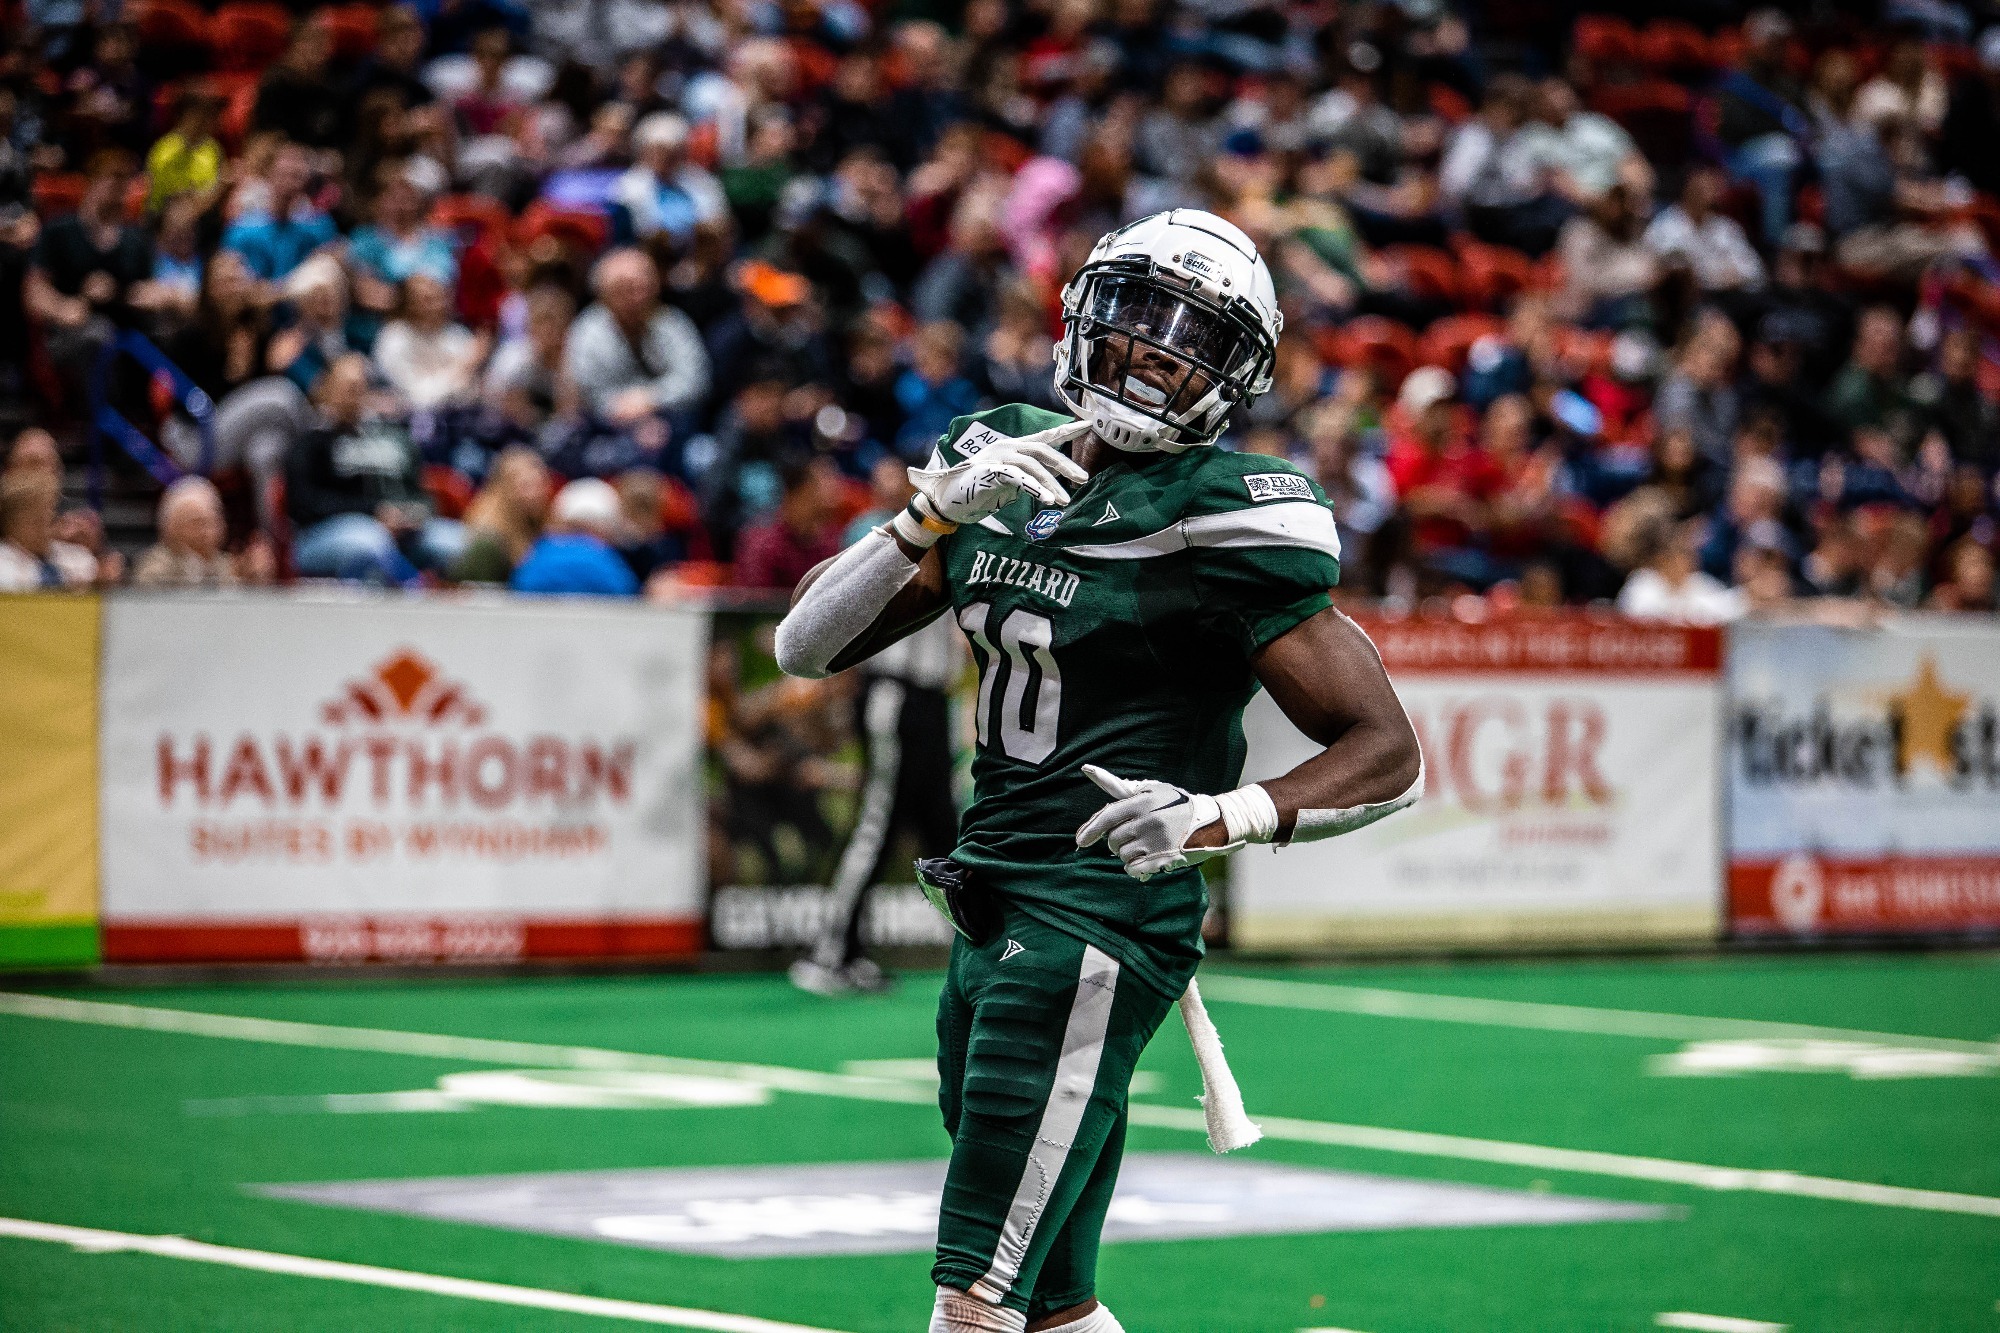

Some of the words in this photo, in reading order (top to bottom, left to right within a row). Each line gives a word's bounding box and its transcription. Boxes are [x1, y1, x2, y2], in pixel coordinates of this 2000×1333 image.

[960, 438, 982, 455] Ba
[975, 430, 998, 445] Au
[965, 550, 1080, 608] BLIZZARD
[958, 600, 1062, 766] 10
[155, 731, 636, 809] HAWTHORN
